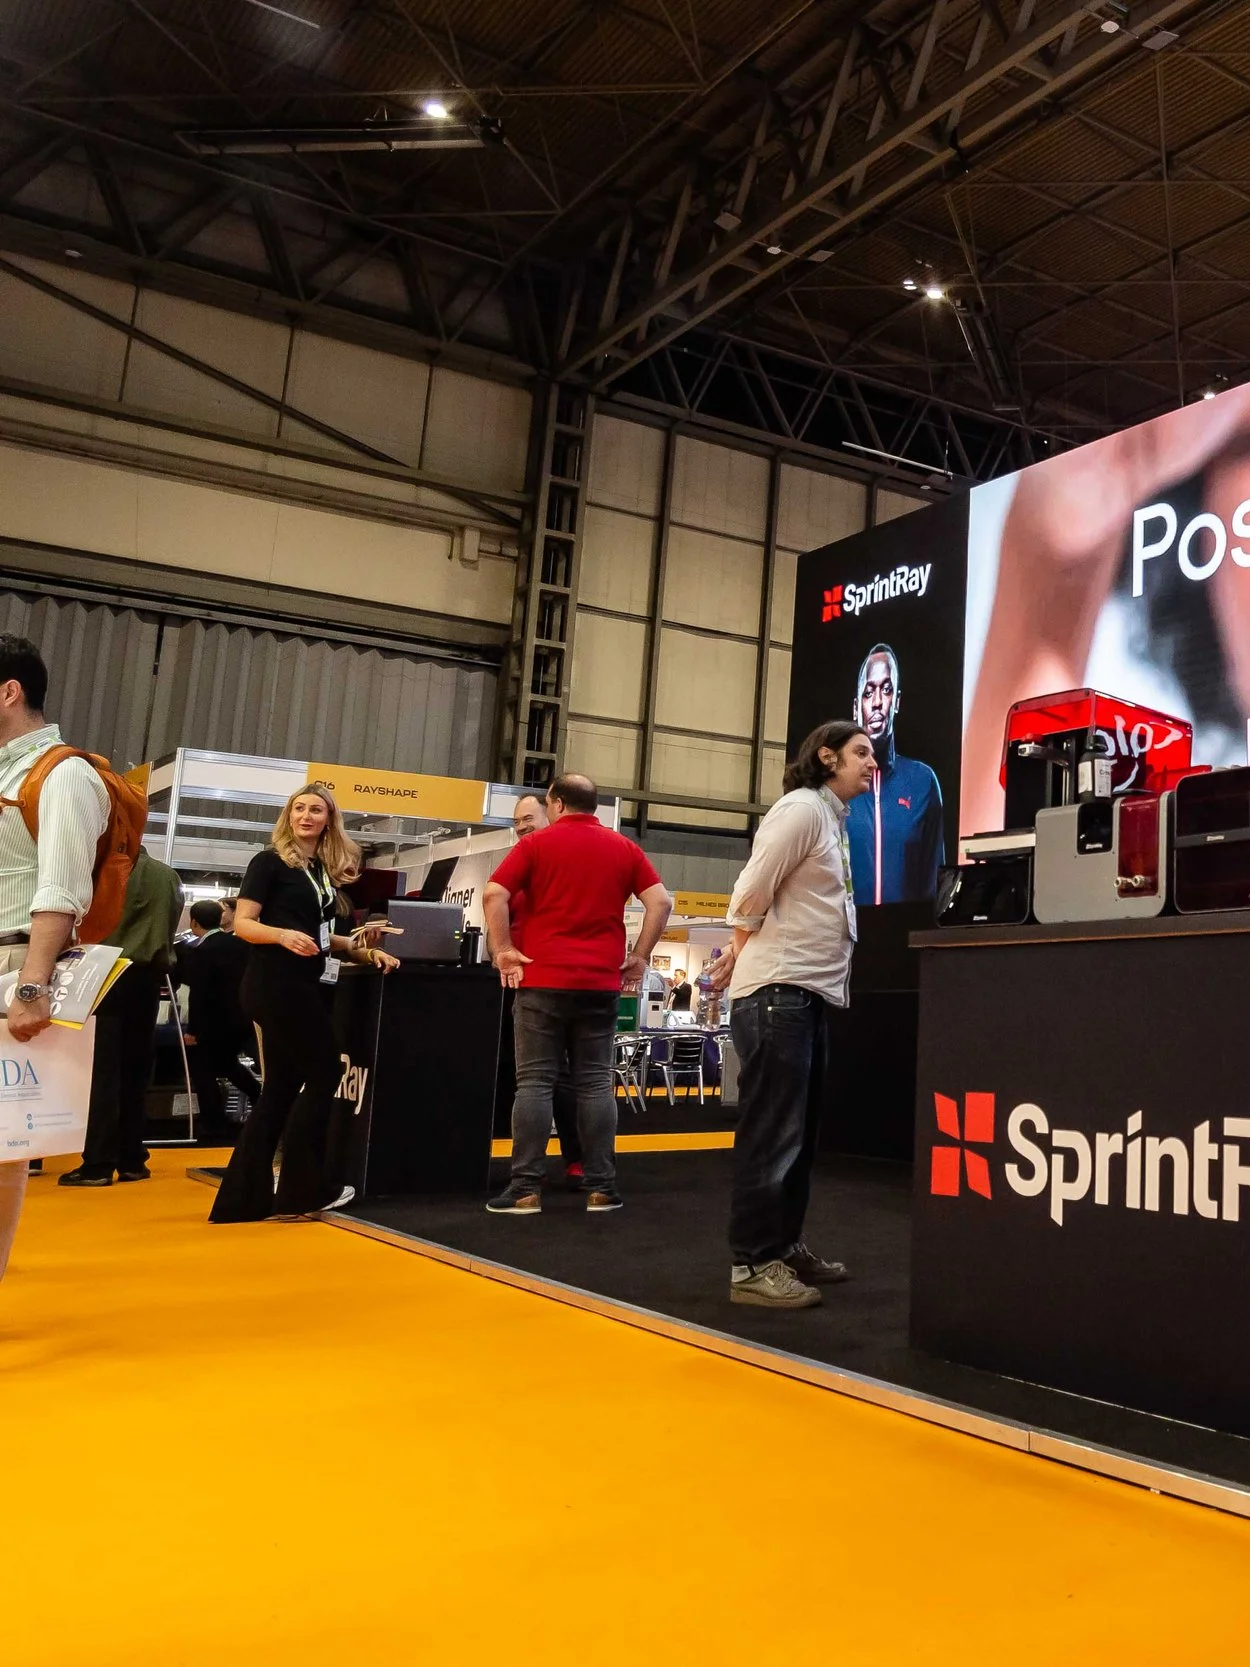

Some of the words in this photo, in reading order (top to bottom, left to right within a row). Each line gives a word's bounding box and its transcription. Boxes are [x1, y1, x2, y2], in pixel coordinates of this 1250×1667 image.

[843, 563, 932, 616] SprintRay
[353, 784, 419, 799] RAYSHAPE
[0, 1058, 40, 1087] DA
